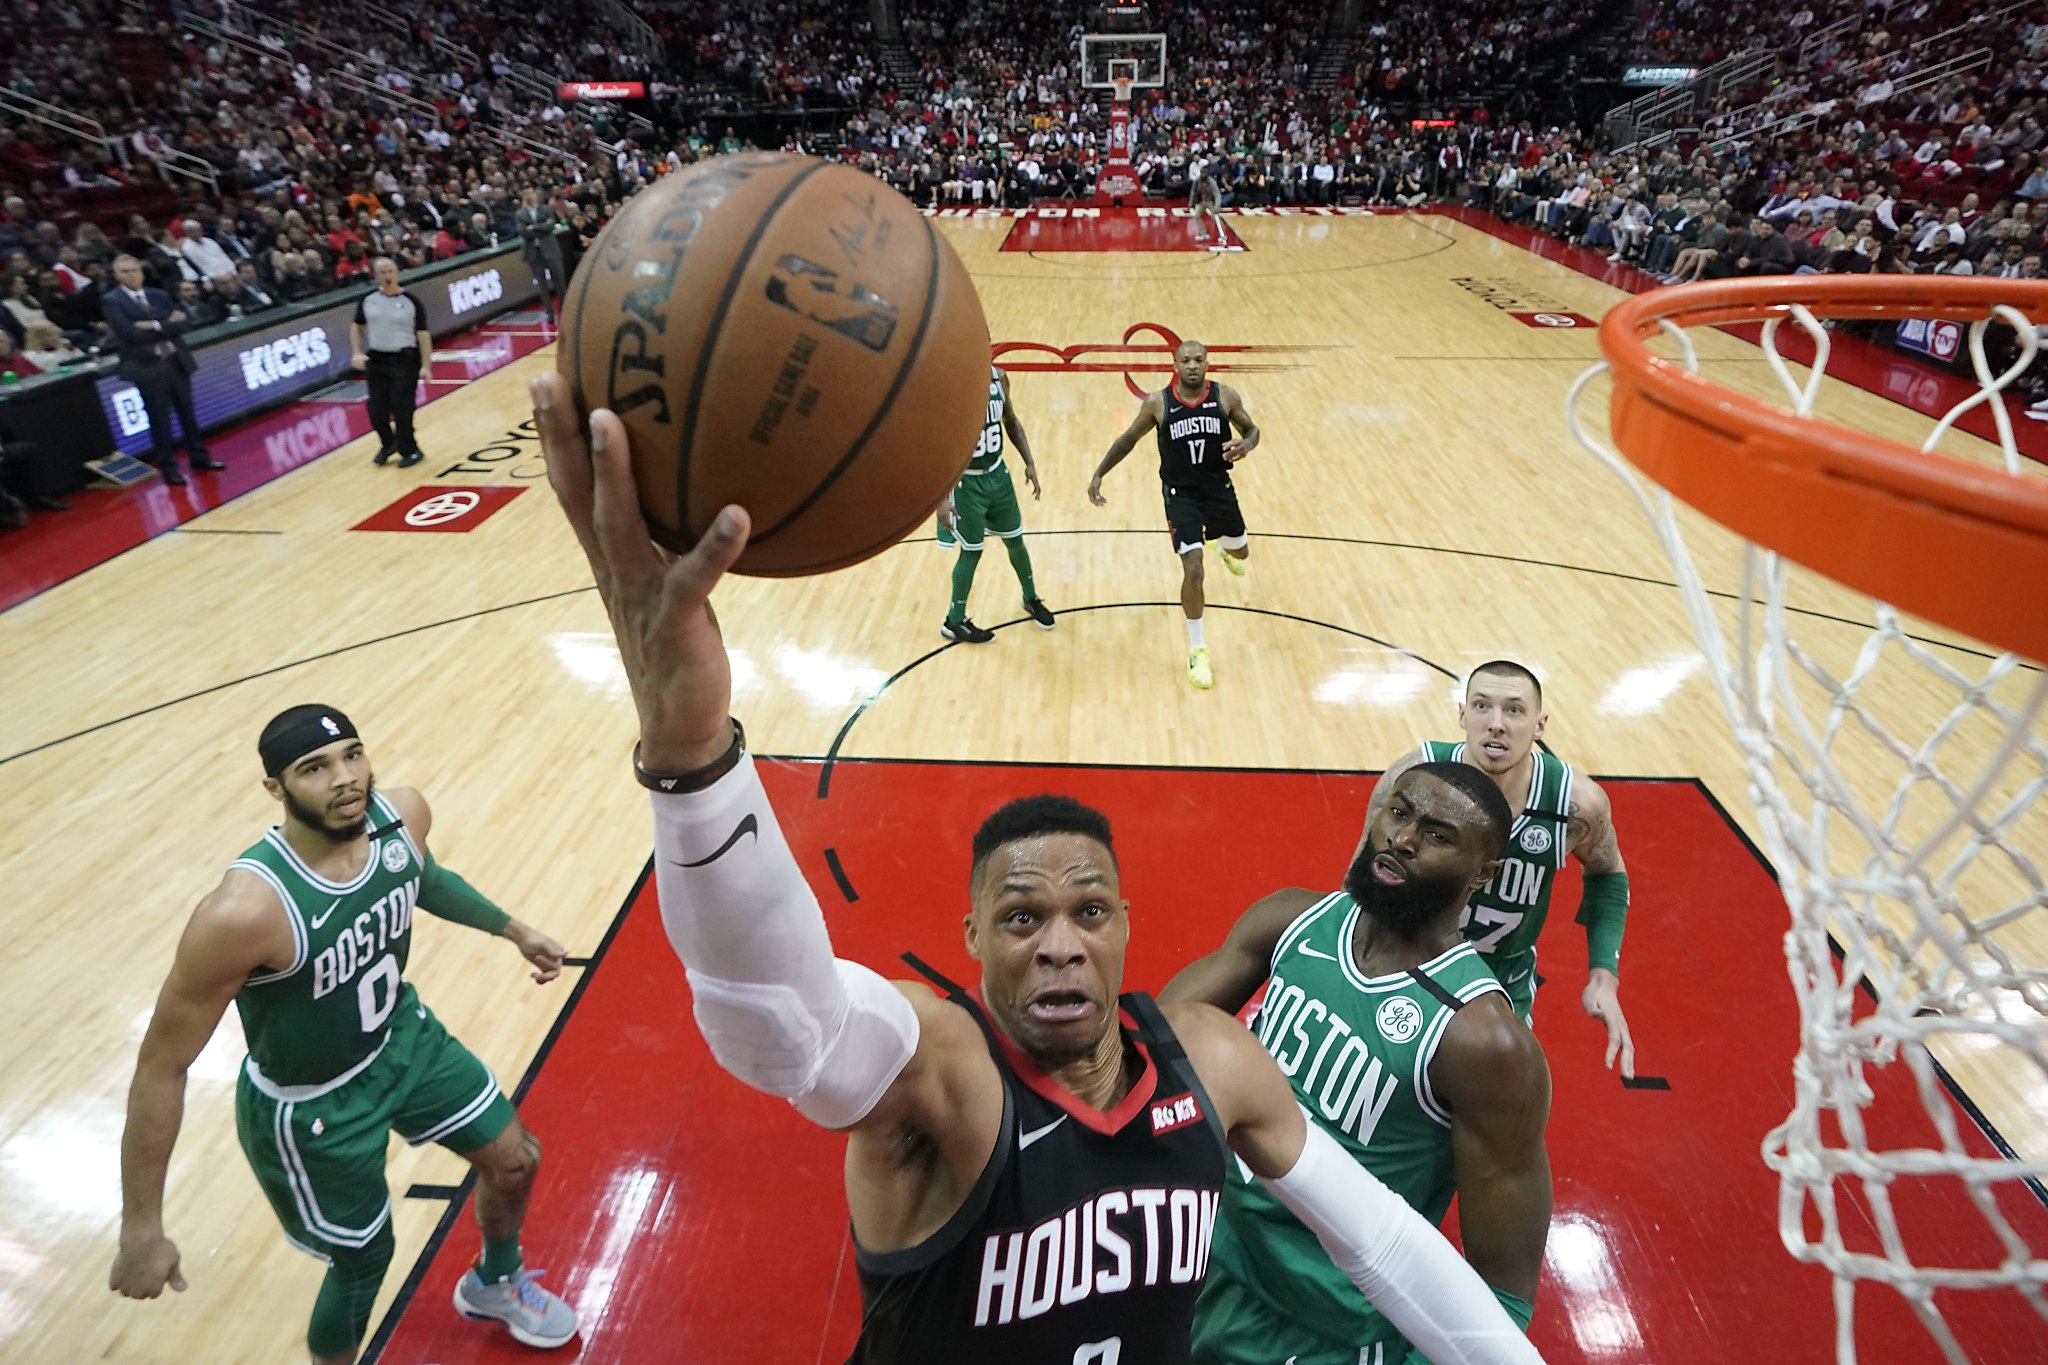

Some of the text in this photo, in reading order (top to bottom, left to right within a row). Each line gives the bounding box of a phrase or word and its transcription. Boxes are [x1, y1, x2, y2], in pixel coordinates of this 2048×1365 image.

[239, 327, 332, 390] KICKS
[1169, 416, 1221, 440] HOUSTON
[1187, 439, 1206, 465] 17
[313, 876, 421, 1000] BOSTON
[357, 953, 400, 1033] 0
[974, 1188, 1220, 1327] HOUSTON
